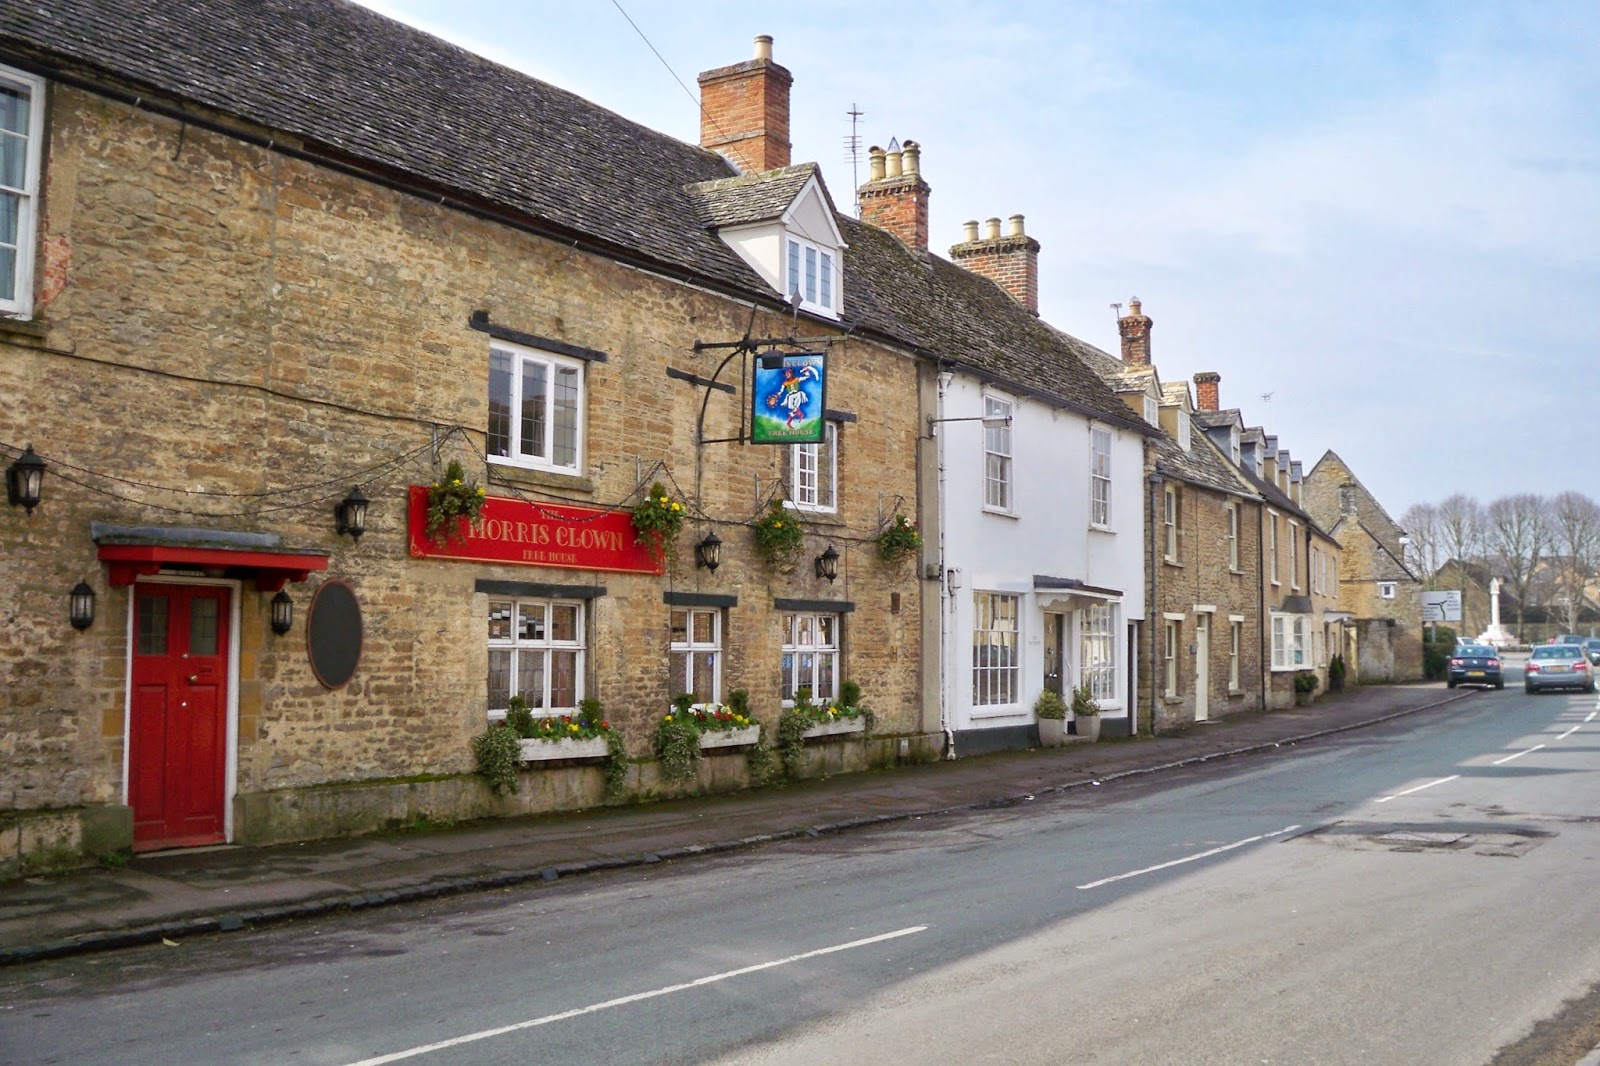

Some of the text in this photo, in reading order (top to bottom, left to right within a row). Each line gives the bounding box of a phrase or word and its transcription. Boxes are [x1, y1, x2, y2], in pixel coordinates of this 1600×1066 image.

[541, 509, 560, 520] THE
[467, 518, 623, 551] MORRIS CLOWN
[523, 549, 577, 563] FREE HOUSE
